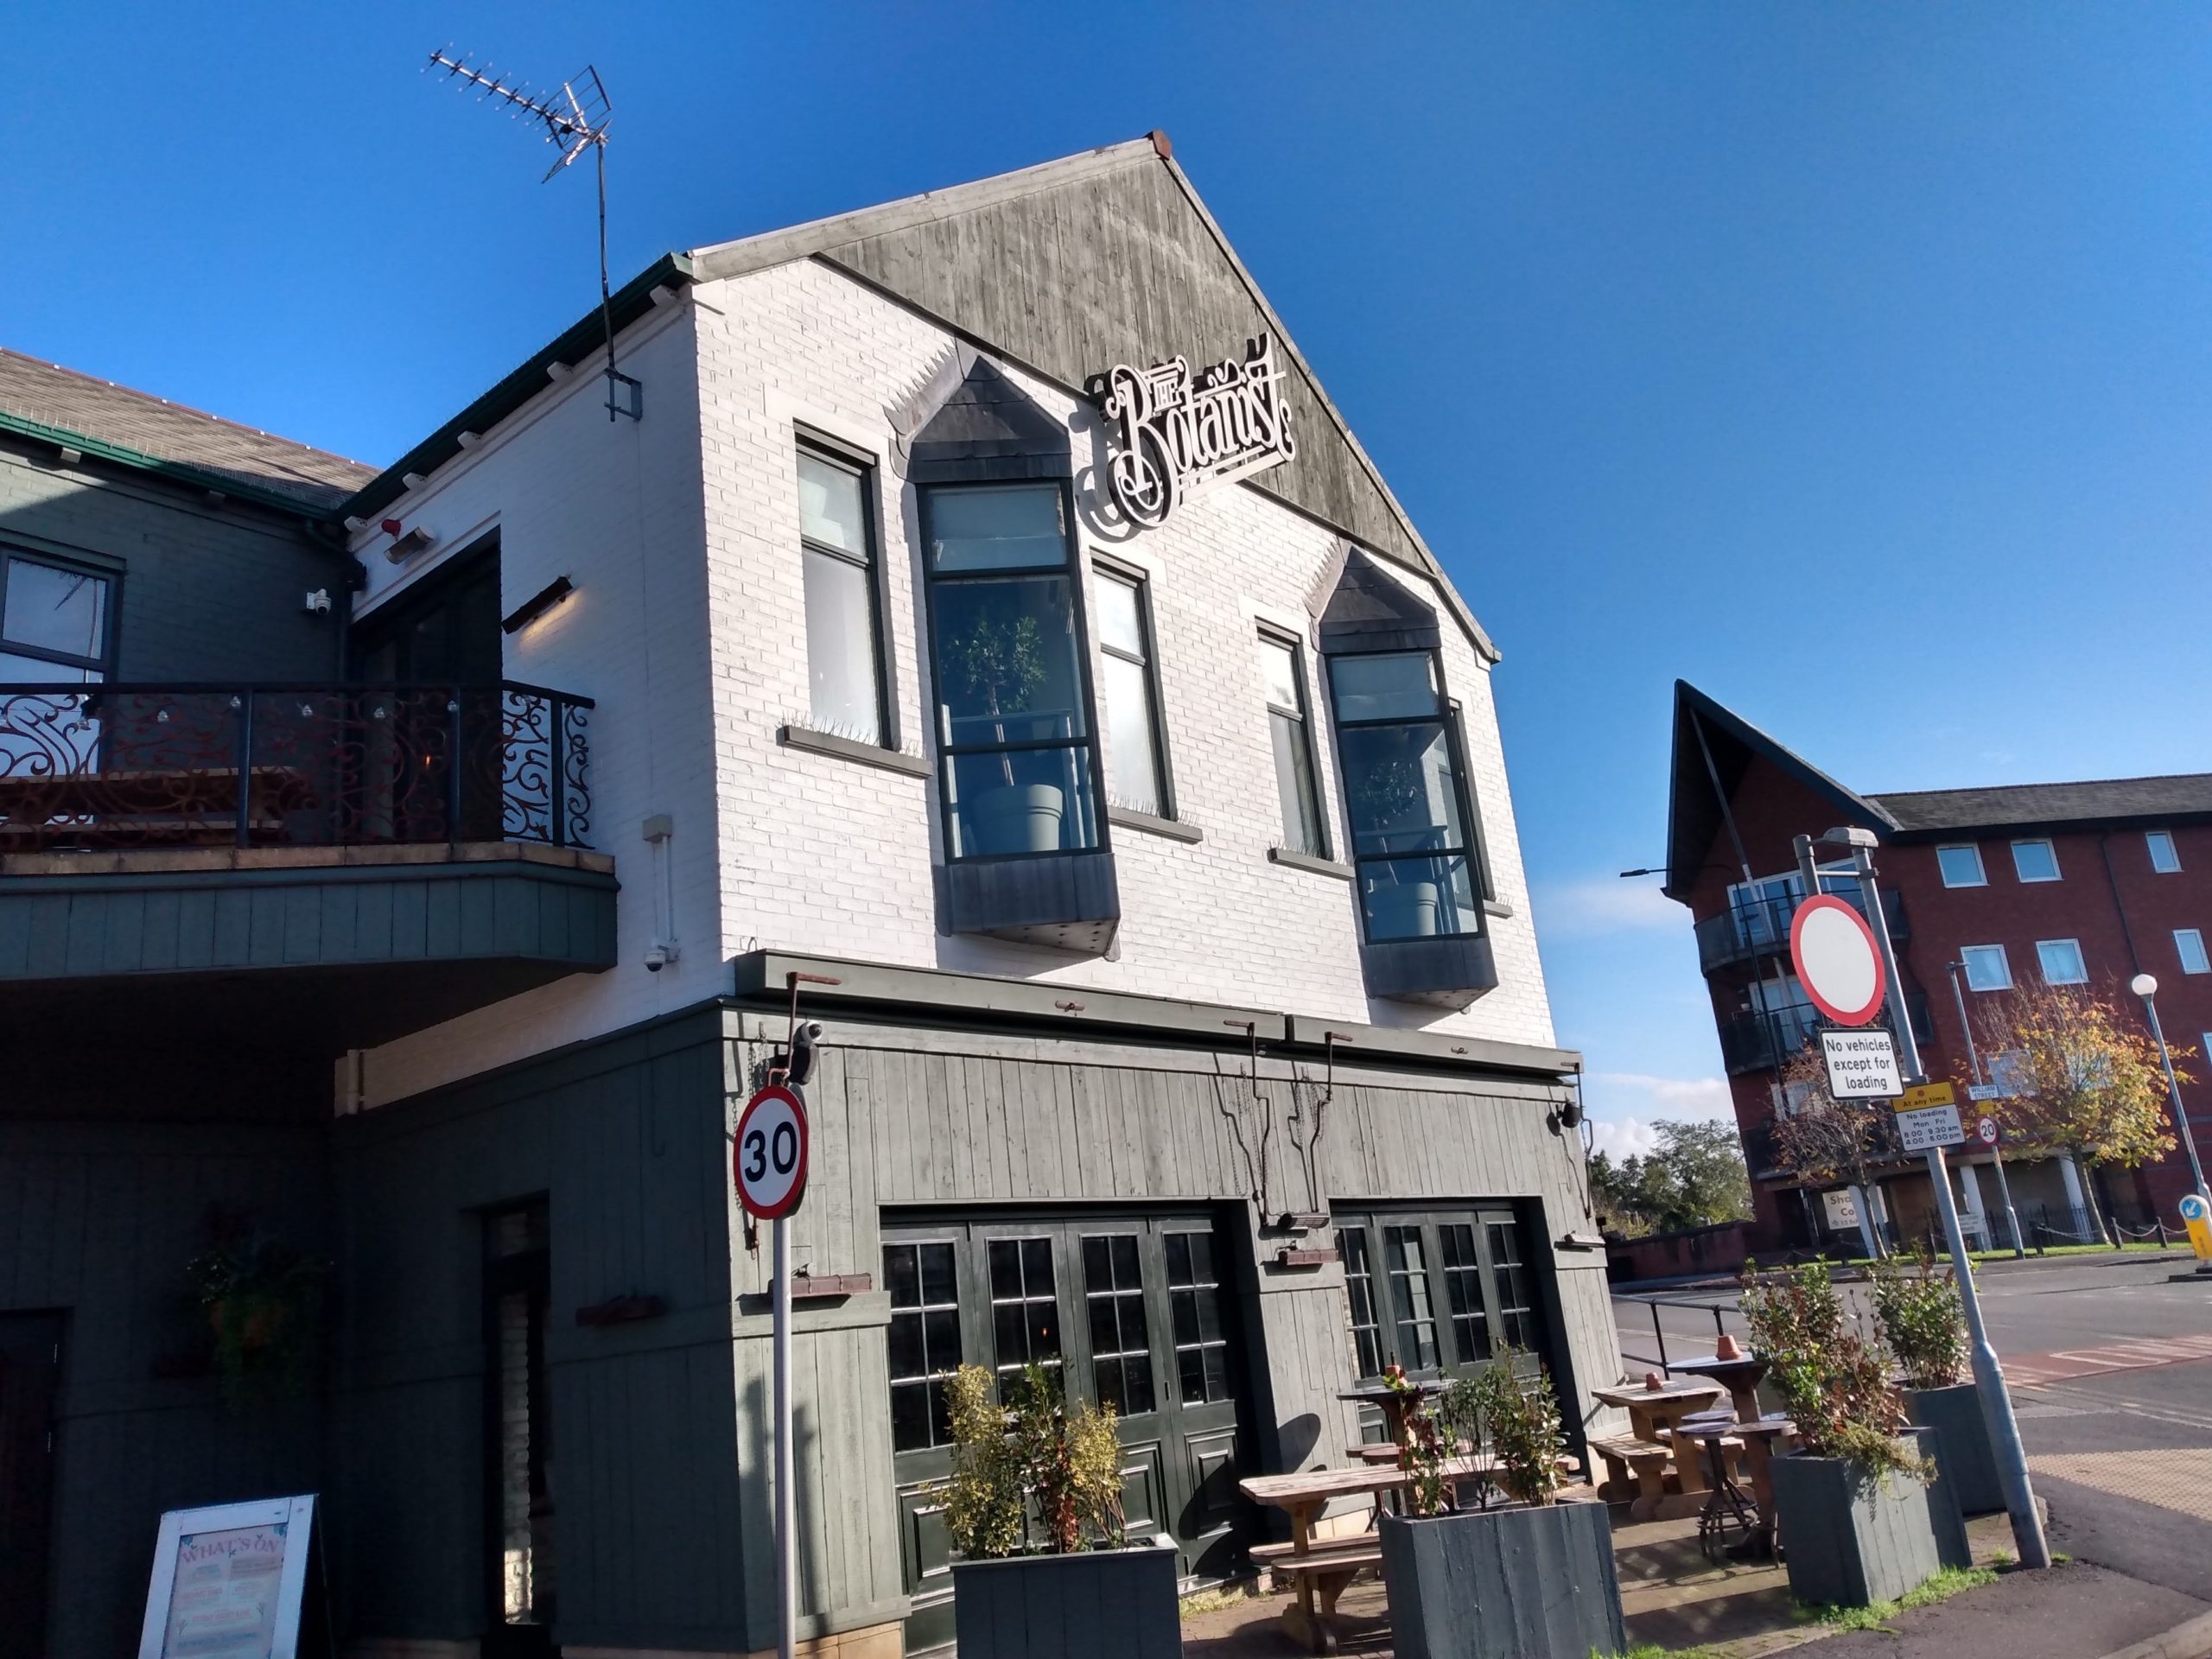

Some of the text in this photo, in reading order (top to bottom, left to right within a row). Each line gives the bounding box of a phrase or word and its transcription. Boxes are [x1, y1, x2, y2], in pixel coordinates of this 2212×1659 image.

[1154, 371, 1183, 412] THE
[1106, 332, 1297, 530] Botanist
[1826, 1038, 1891, 1052] No vehicles
[1834, 1056, 1890, 1071] except for
[1846, 1076, 1887, 1090] loading
[1920, 1109, 1948, 1118] loading
[1981, 1123, 1994, 1137] 20
[744, 1121, 798, 1183] 30
[1830, 1196, 1852, 1205] Sha
[1840, 1207, 1854, 1217] Co
[182, 1538, 276, 1563] WHAT'S ON
